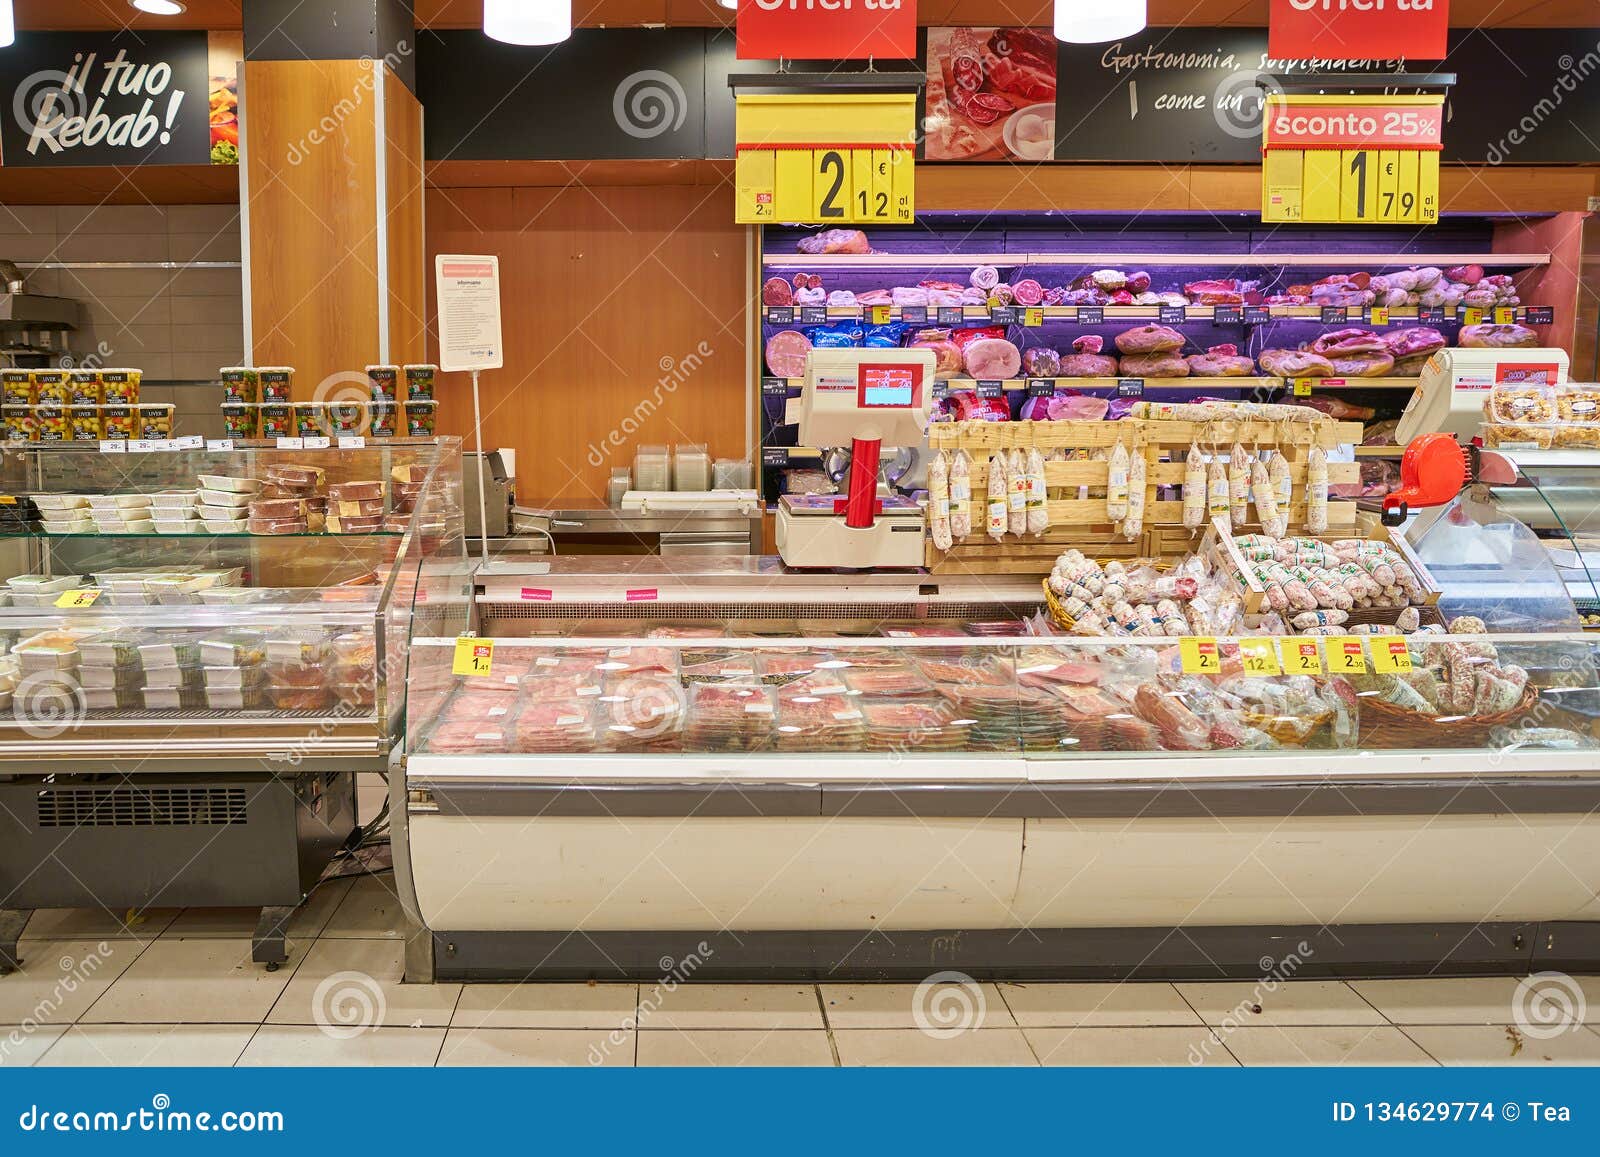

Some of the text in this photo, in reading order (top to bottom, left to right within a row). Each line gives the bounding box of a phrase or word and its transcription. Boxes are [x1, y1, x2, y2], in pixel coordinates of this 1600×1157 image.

[62, 49, 172, 96] il tuo
[1101, 43, 1241, 73] Gastronomia,
[1154, 94, 1206, 110] come
[1217, 95, 1242, 110] un
[26, 92, 185, 155] kebab!
[1275, 112, 1436, 136] sconto 25%
[820, 151, 845, 217] 2
[1351, 151, 1367, 218] 1
[898, 207, 909, 219] hg
[1423, 207, 1435, 219] hg
